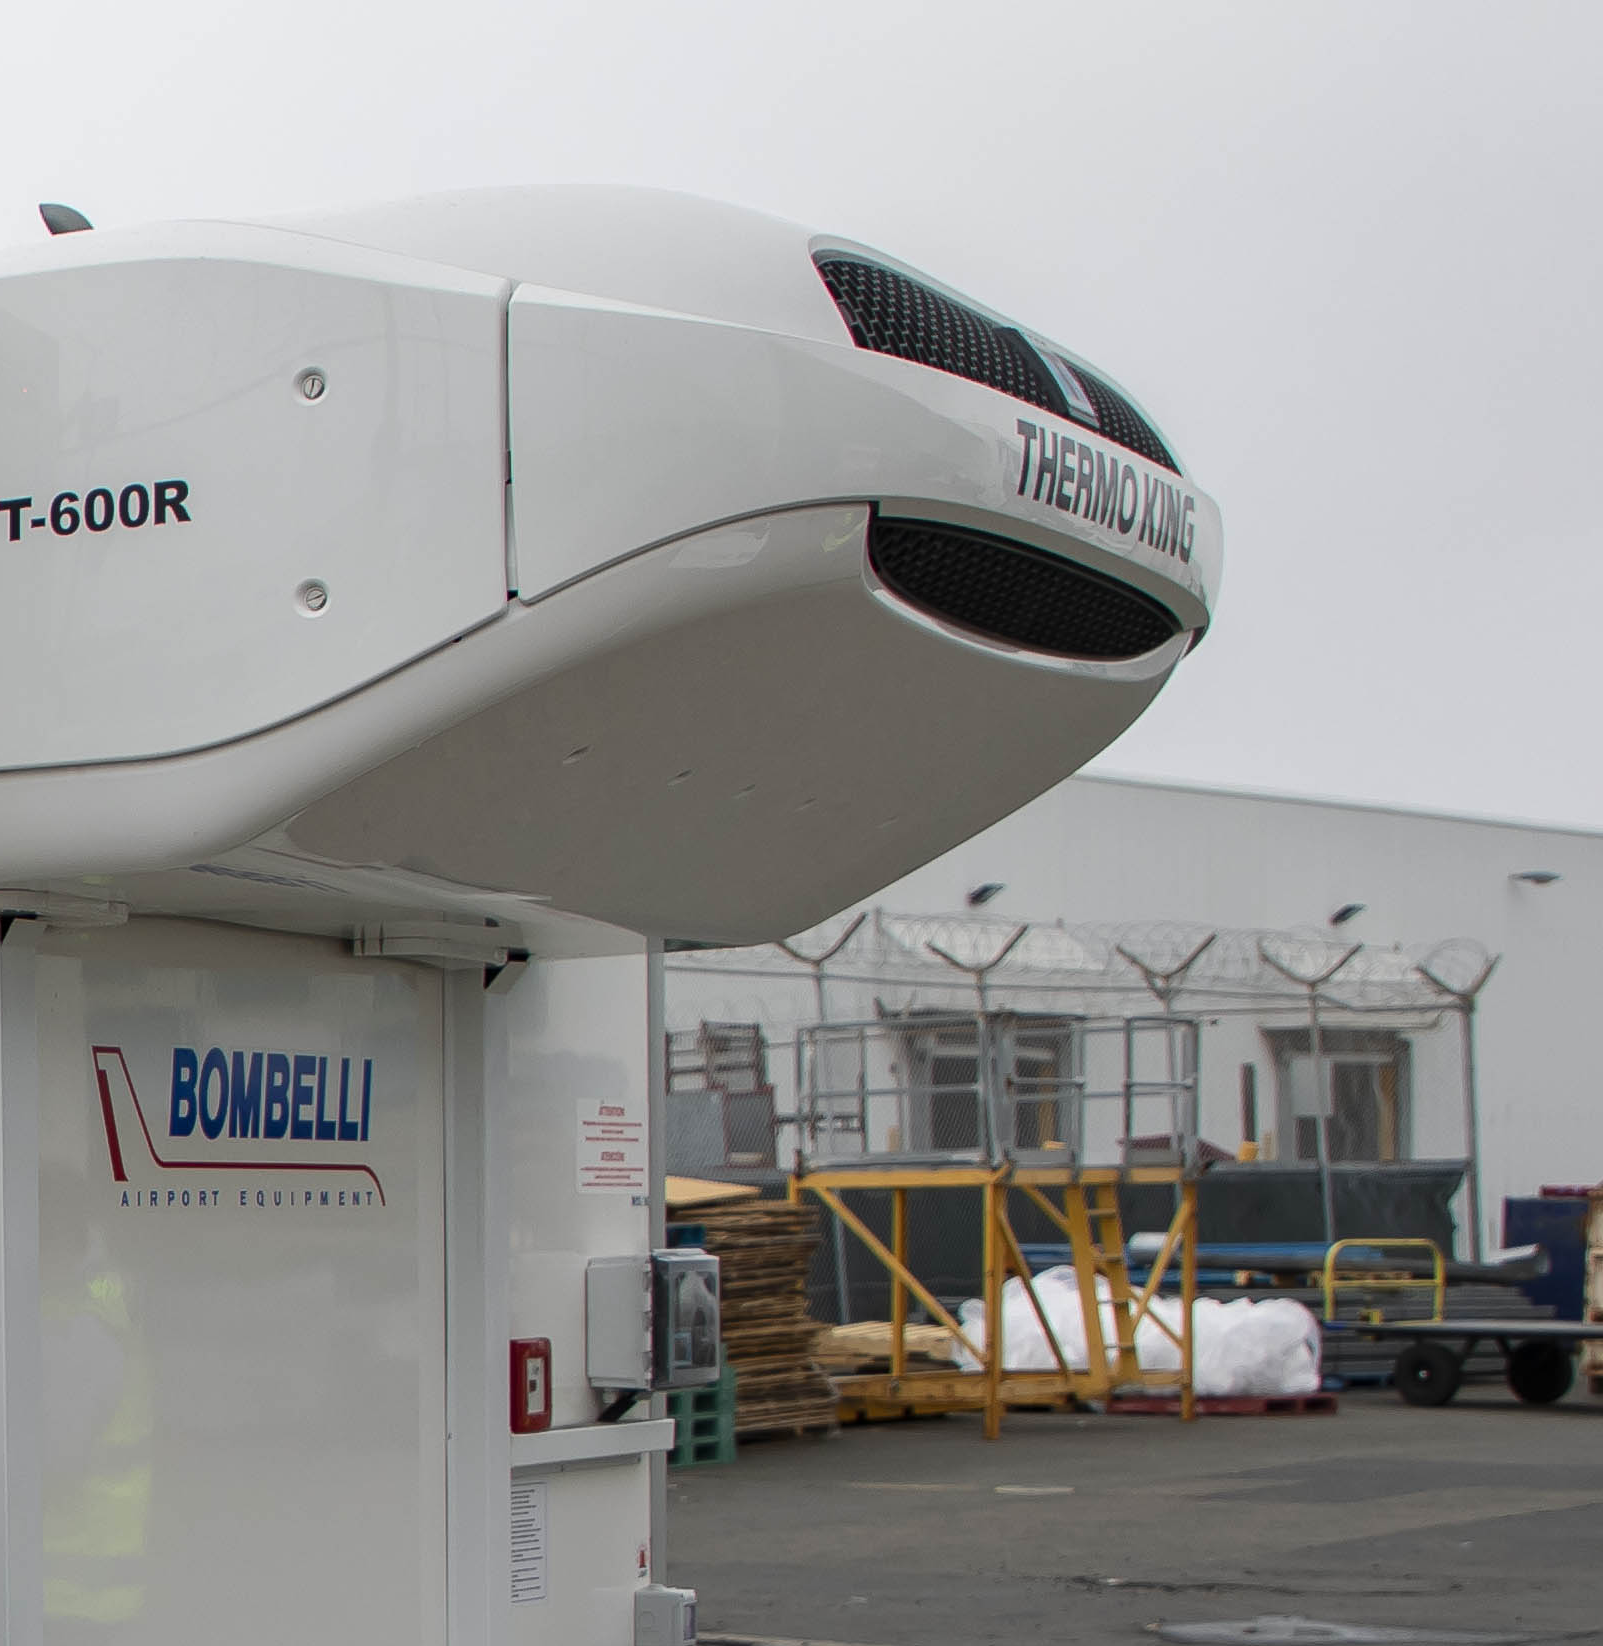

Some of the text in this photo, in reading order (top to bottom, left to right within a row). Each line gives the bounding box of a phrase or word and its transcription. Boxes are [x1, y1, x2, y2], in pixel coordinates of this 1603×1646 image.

[1016, 418, 1196, 564] THERMO KING
[168, 1046, 373, 1142] BOMBELLI
[120, 1189, 373, 1208] AIRPORT EQUIPMENT
